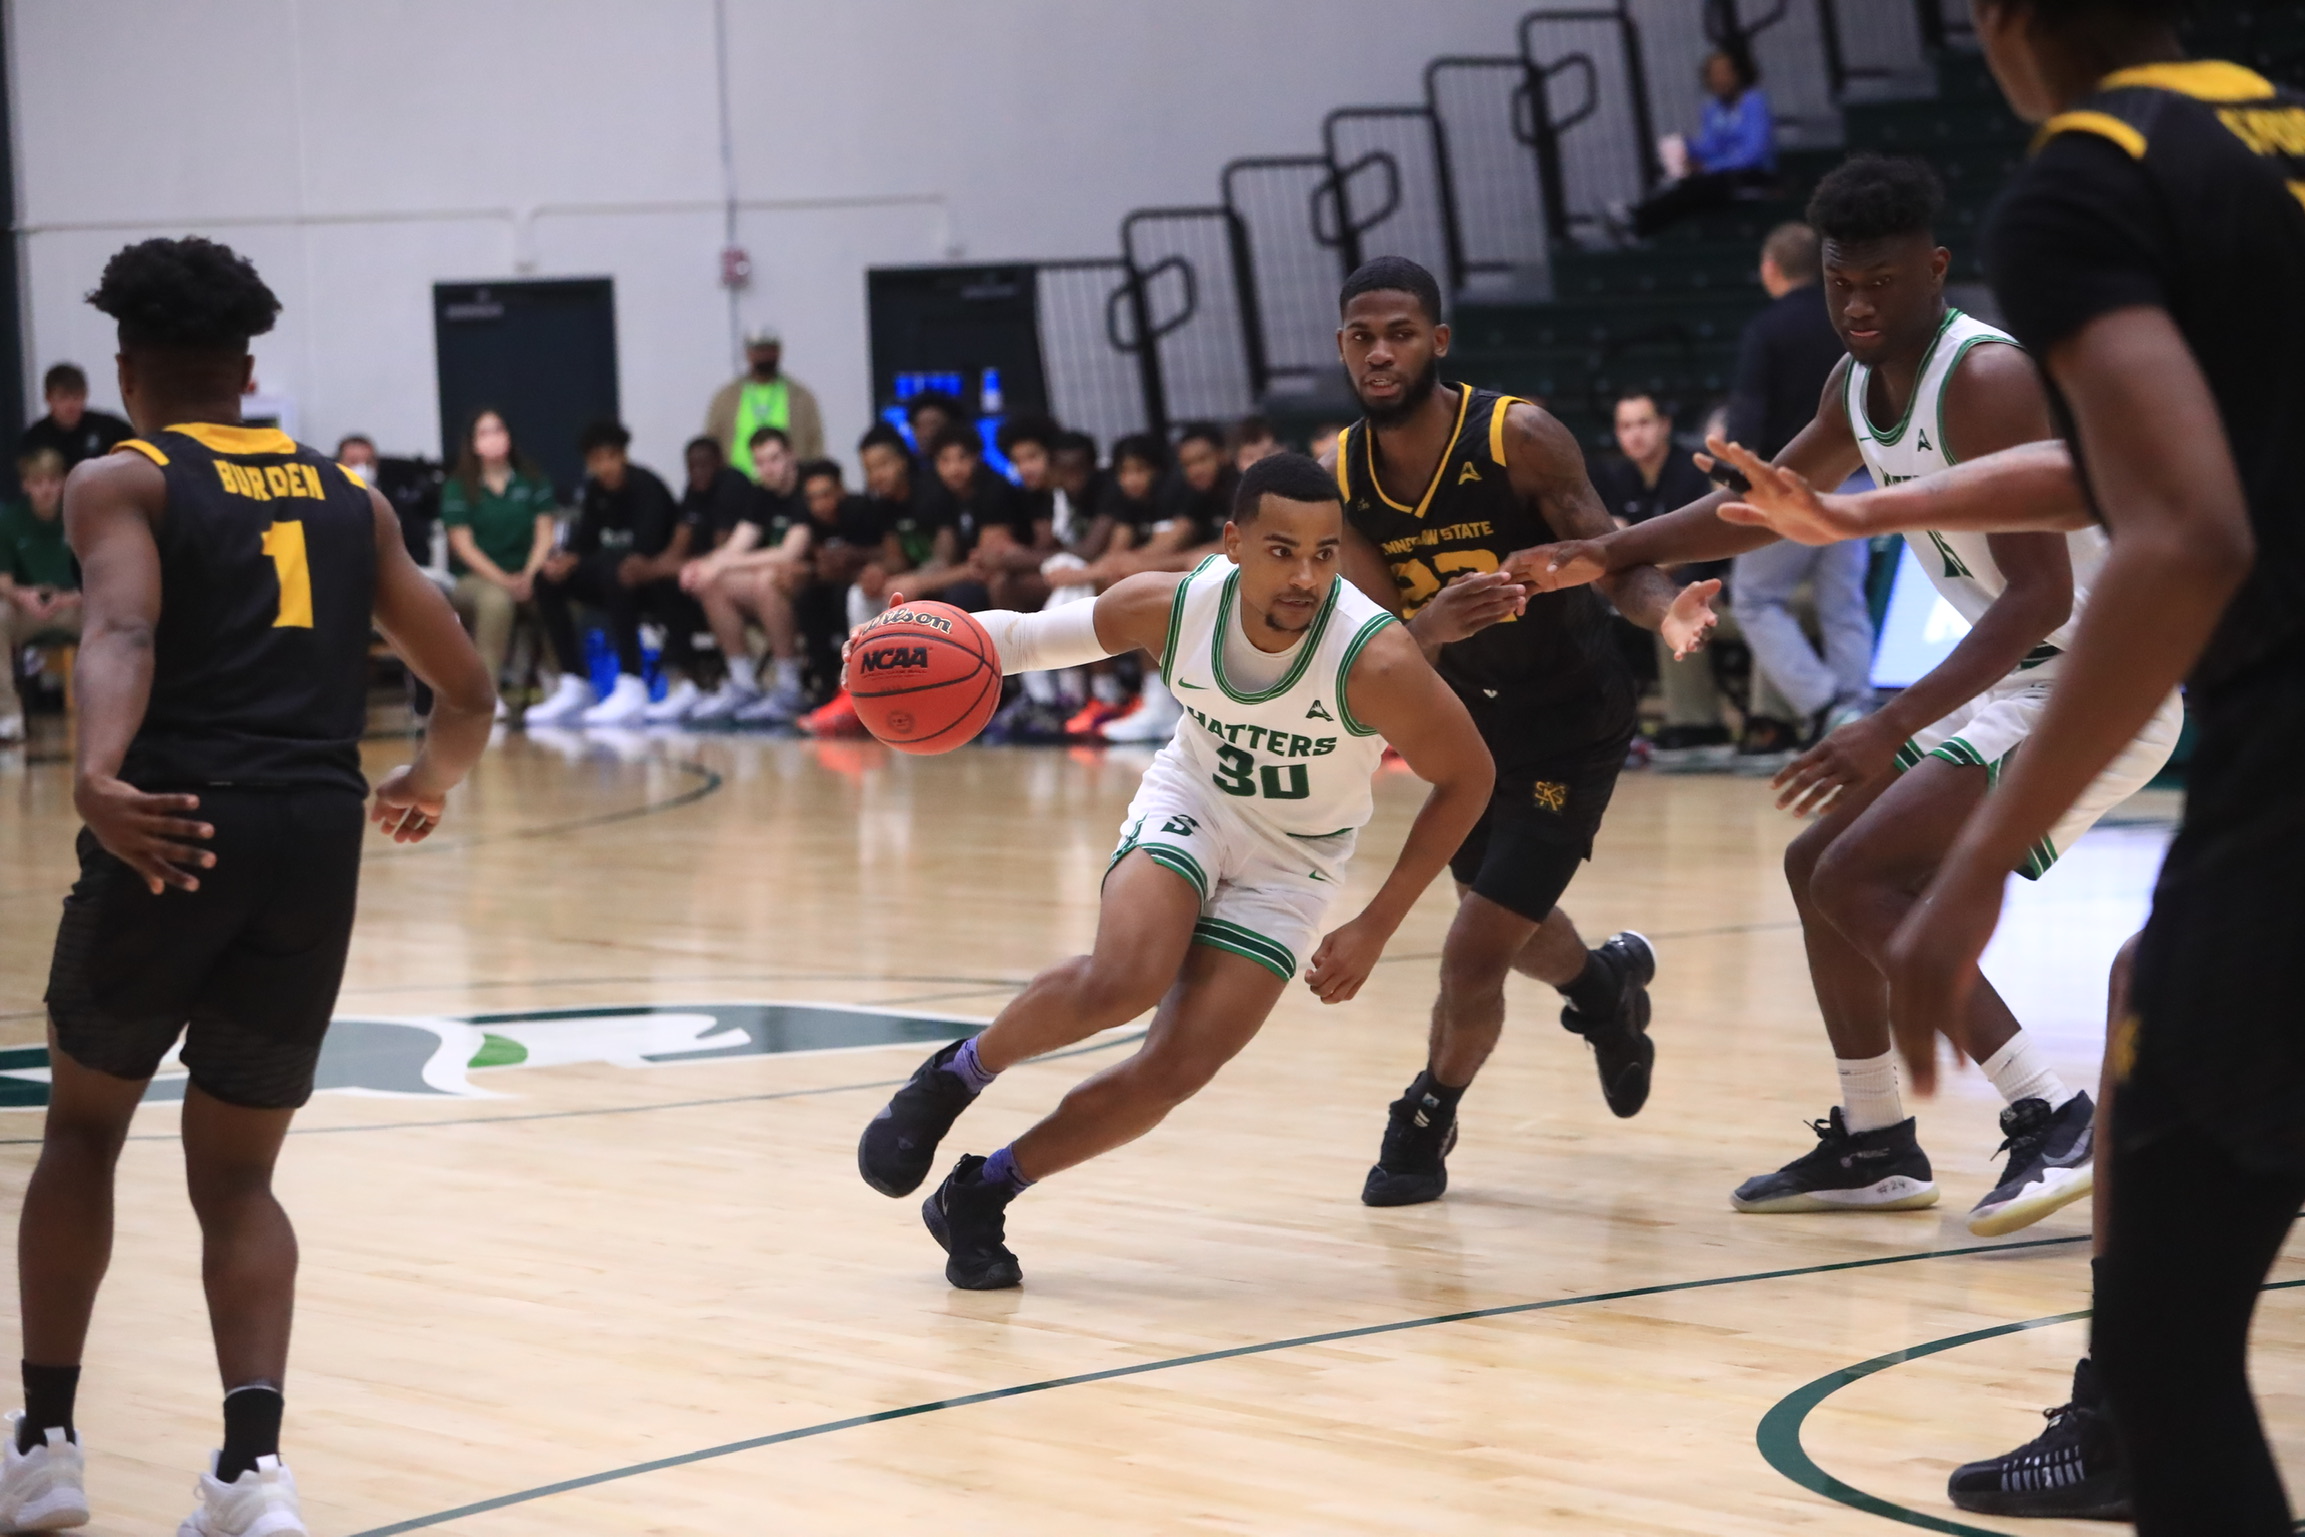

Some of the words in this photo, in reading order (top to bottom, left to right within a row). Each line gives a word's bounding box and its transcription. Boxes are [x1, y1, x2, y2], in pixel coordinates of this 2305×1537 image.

[213, 459, 326, 501] BURDEN
[1440, 521, 1494, 541] STATE
[260, 520, 314, 629] 1
[860, 647, 928, 674] NCAA
[1186, 705, 1338, 758] HATTERS
[1212, 743, 1310, 800] 30
